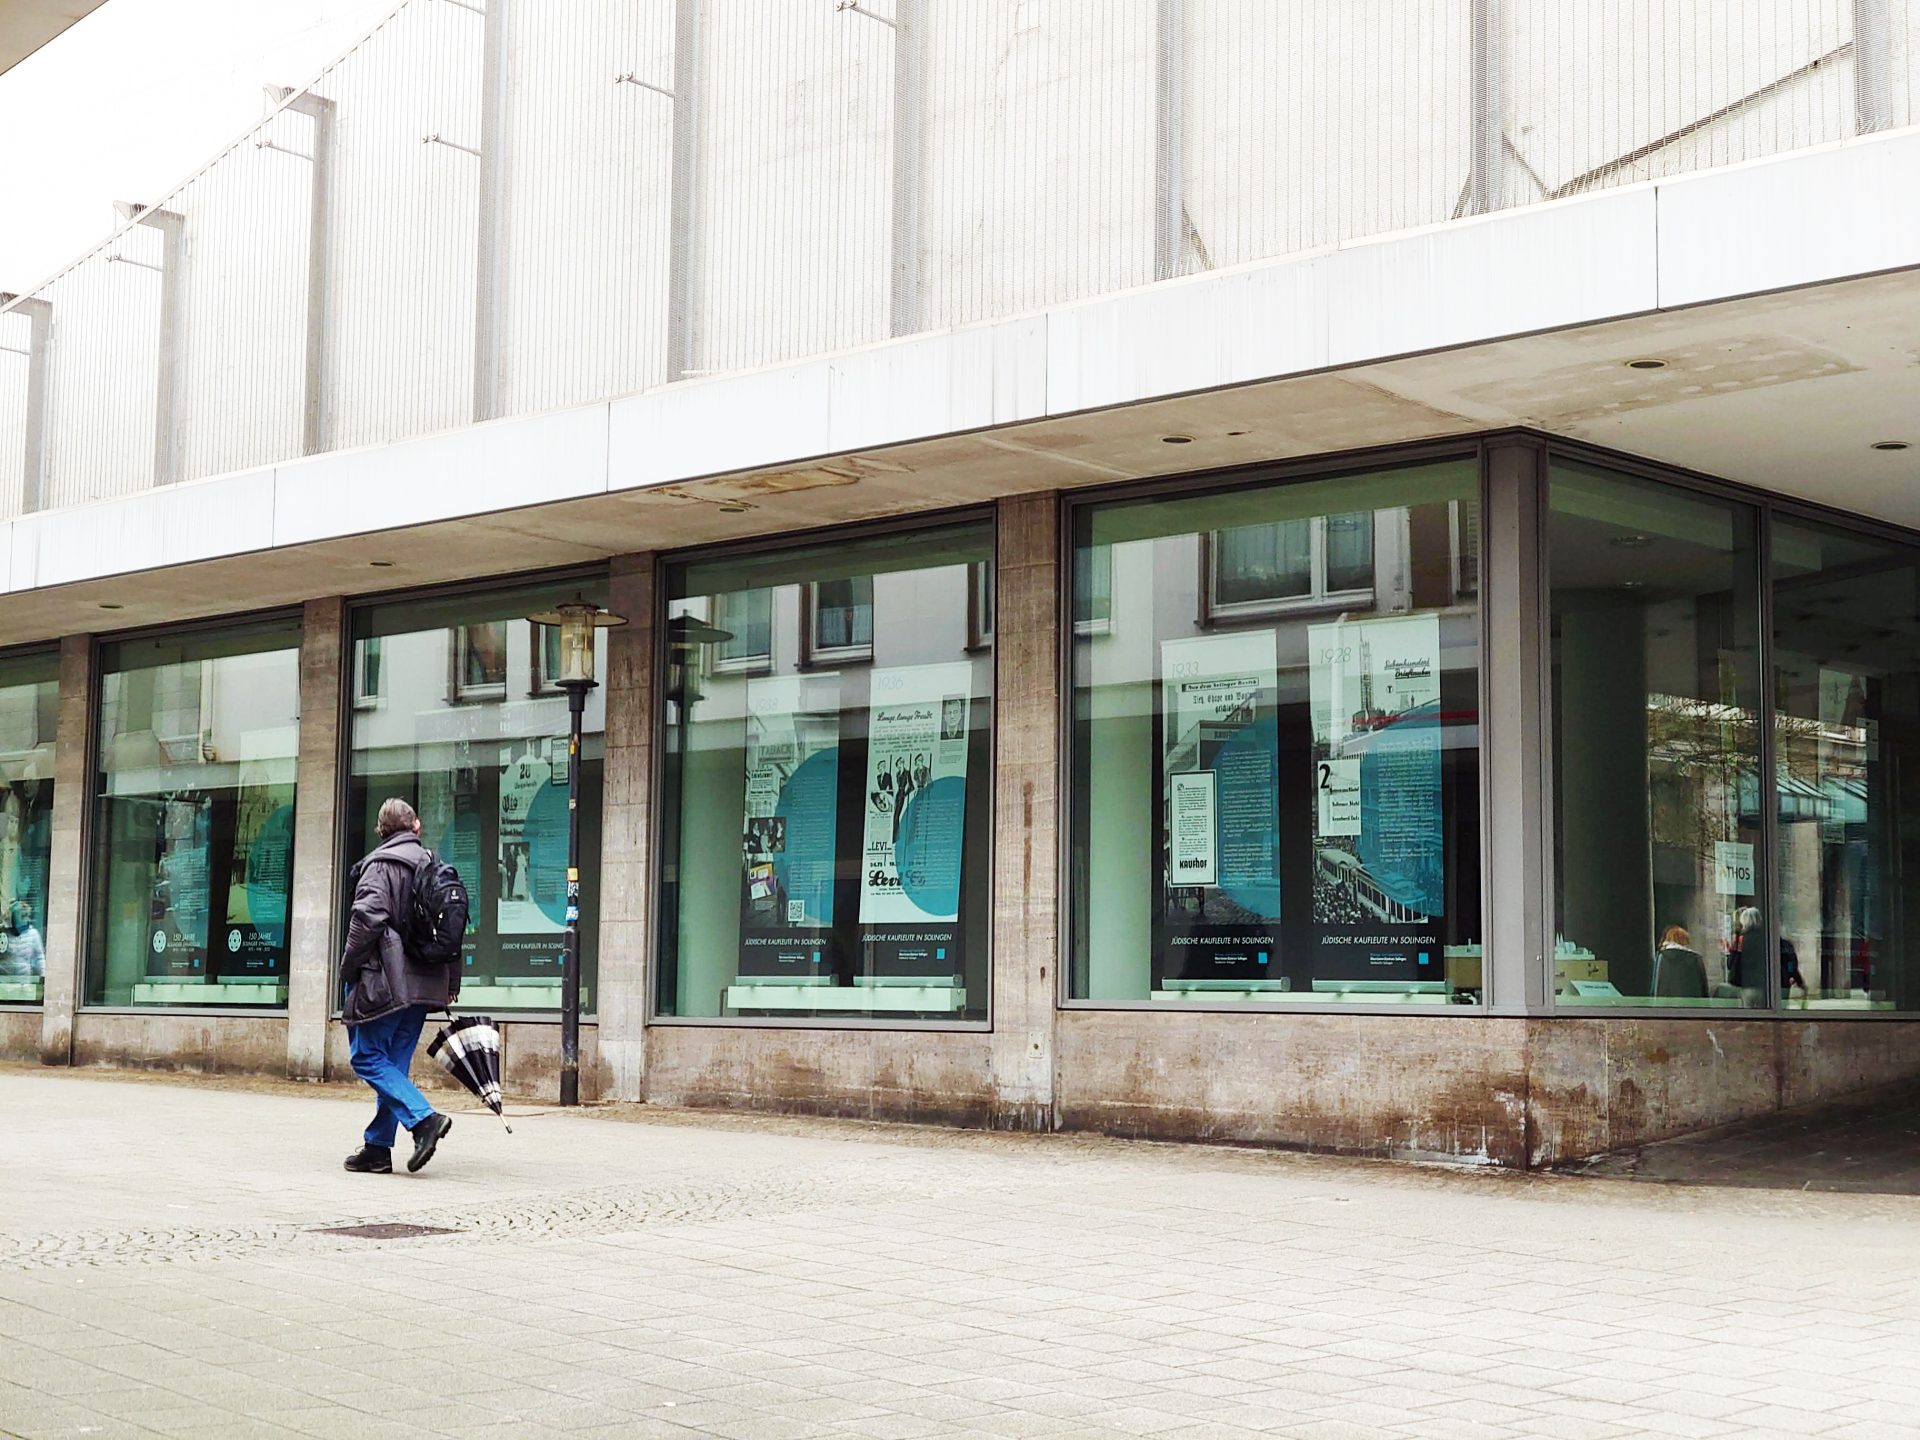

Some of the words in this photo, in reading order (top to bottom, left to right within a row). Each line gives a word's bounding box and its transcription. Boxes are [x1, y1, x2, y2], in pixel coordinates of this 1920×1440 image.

[1320, 647, 1352, 664] 1928
[1319, 763, 1331, 789] 2
[916, 933, 923, 941] IN
[924, 933, 952, 941] SOLINGEN
[1171, 936, 1198, 945] JÜDISCHE
[1200, 937, 1231, 945] KAUFLEUTE
[1232, 937, 1240, 945] IN
[1241, 936, 1274, 945] SOLINGEN
[1321, 935, 1352, 945] JÜDISCHE
[1353, 936, 1388, 945] KAUFLEUTE
[1389, 936, 1399, 944] IN
[1400, 936, 1436, 944] SOLINGEN
